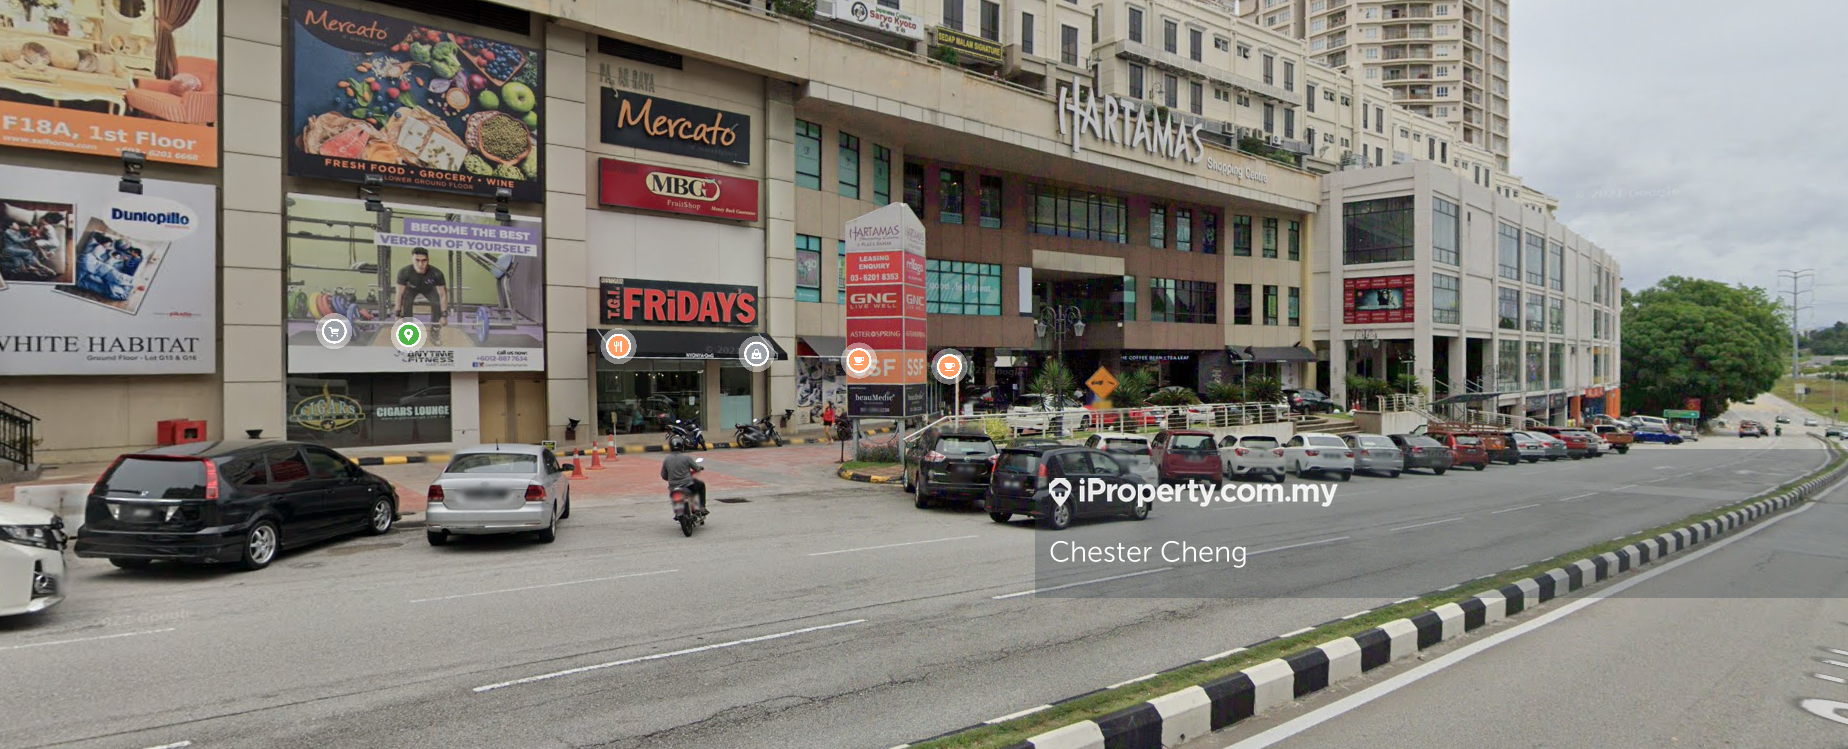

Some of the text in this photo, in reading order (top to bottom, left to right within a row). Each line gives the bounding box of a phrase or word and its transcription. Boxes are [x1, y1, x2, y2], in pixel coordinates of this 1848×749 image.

[304, 9, 388, 40] Mercato
[869, 9, 893, 23] Saryo
[894, 17, 917, 30] Kyoto
[938, 32, 1001, 56] SEDAP MALAM SIGNATURE
[599, 63, 630, 88] PAAR
[617, 98, 736, 146] Mercato
[1058, 76, 1205, 164] HARTAMAS
[2, 115, 198, 150] F18A, 1st Floor
[147, 149, 173, 158] 6201
[324, 158, 515, 189] FRESH FOOD GROCERY WINE
[1207, 157, 1268, 183] Shopping Centre
[384, 175, 474, 190] LOWER GROUND FLOOR
[652, 173, 707, 198] MBG
[667, 199, 701, 211] FruitShop
[111, 207, 190, 225] Dunlopillo
[410, 222, 530, 241] BECOME THE BEST
[849, 225, 900, 241] HARTAMAS
[379, 234, 531, 255] VERSION OF YOURSELF
[850, 274, 859, 282] 03
[863, 273, 880, 281] 6201
[881, 273, 899, 281] 8353
[607, 286, 621, 319] T.G.I.
[850, 292, 897, 304] GNC
[906, 293, 925, 307] GNC
[86, 336, 200, 353] HABITAT
[907, 358, 924, 376] SSF
[376, 405, 450, 418] CIGARS LOUNGE
